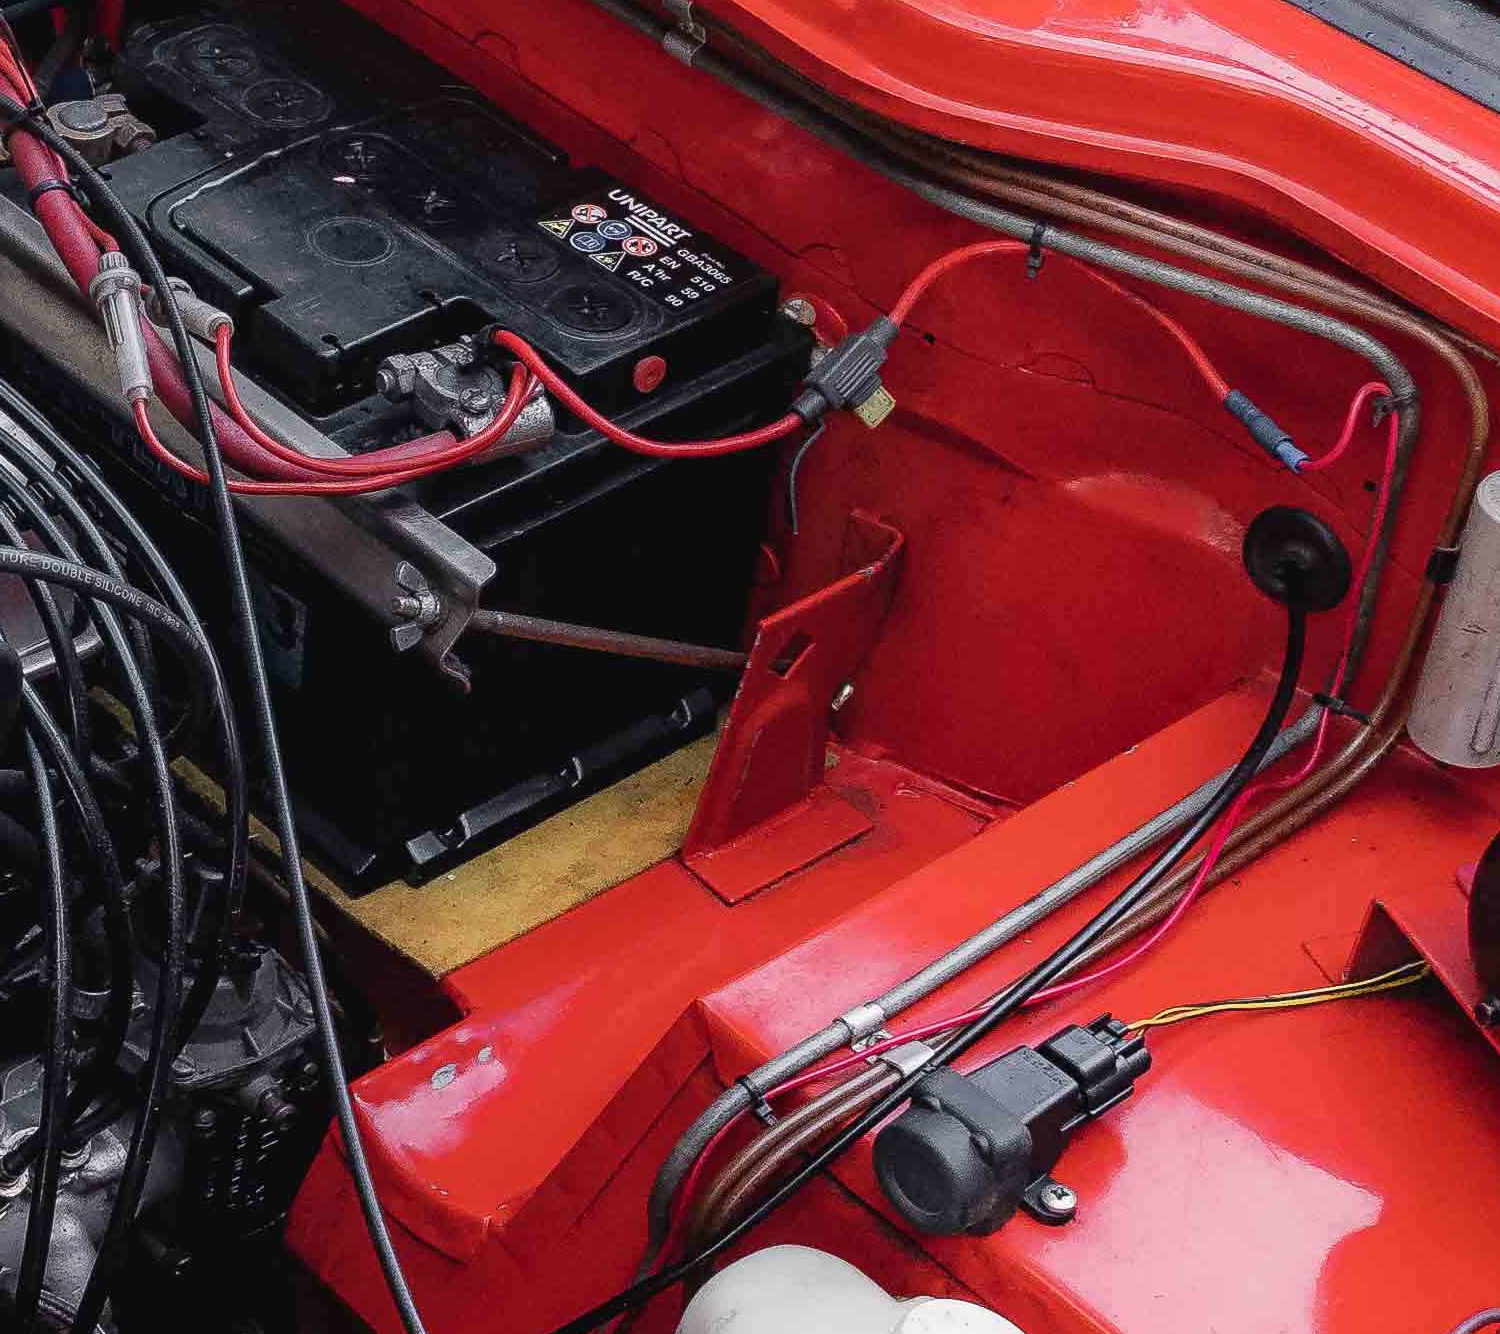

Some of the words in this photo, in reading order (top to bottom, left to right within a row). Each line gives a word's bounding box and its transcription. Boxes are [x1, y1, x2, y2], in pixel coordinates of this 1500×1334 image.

[608, 188, 692, 239] UNIPART
[659, 255, 682, 270] EN
[690, 275, 716, 293] 510
[676, 248, 734, 284] GBA3065
[626, 270, 655, 289] R/C
[664, 294, 684, 308] 90
[680, 286, 701, 300] 59
